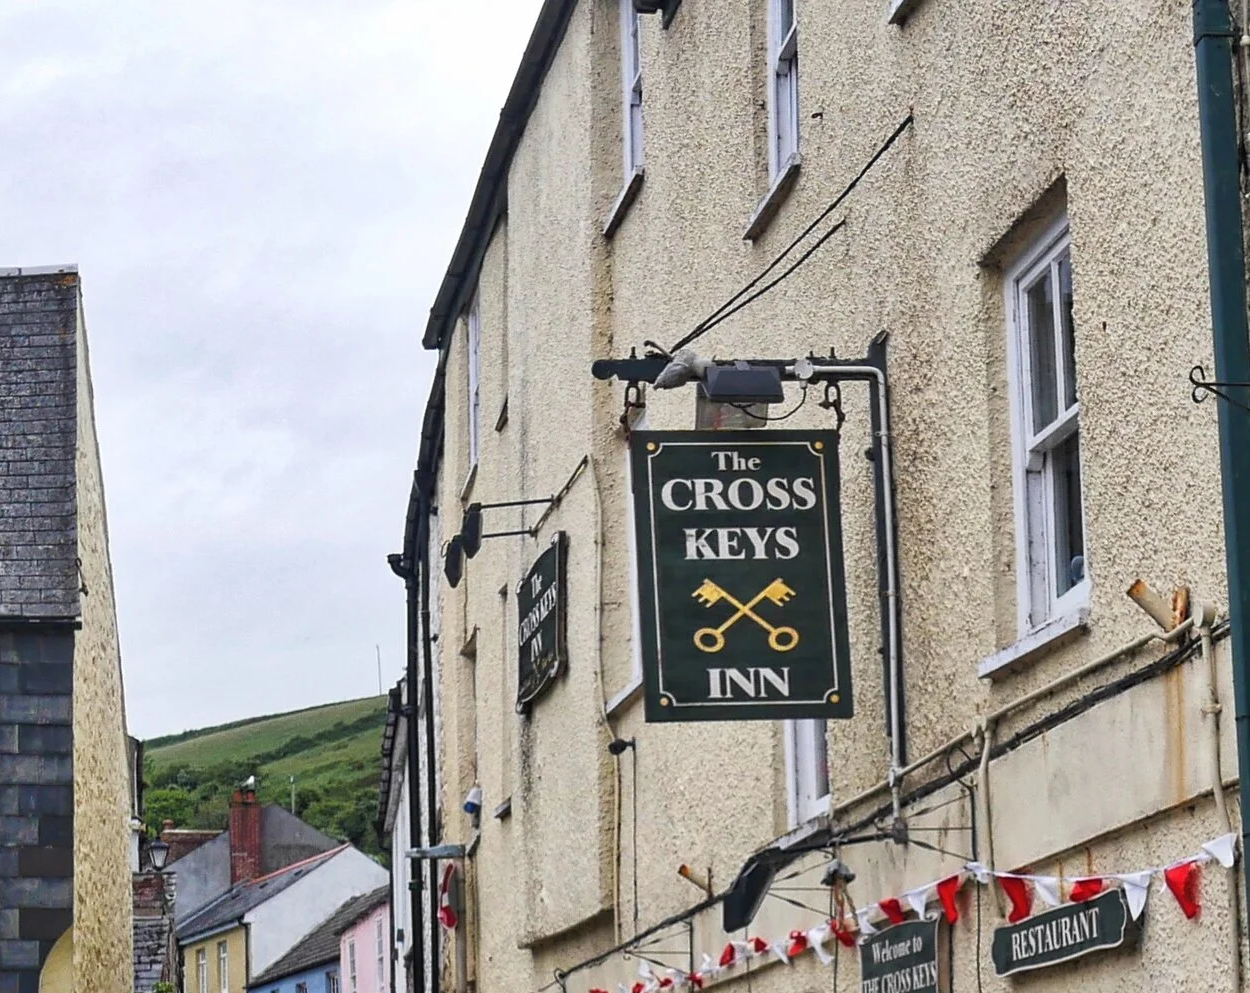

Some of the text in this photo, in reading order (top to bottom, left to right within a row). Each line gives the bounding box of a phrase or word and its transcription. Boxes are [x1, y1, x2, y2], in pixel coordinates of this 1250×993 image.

[711, 451, 761, 471] The
[661, 477, 816, 511] CROSS
[683, 527, 799, 560] KEYS
[707, 668, 789, 698] INN
[1012, 907, 1099, 961] RESTAURANT
[872, 936, 923, 963] Welcome to
[912, 960, 937, 990] KEYS
